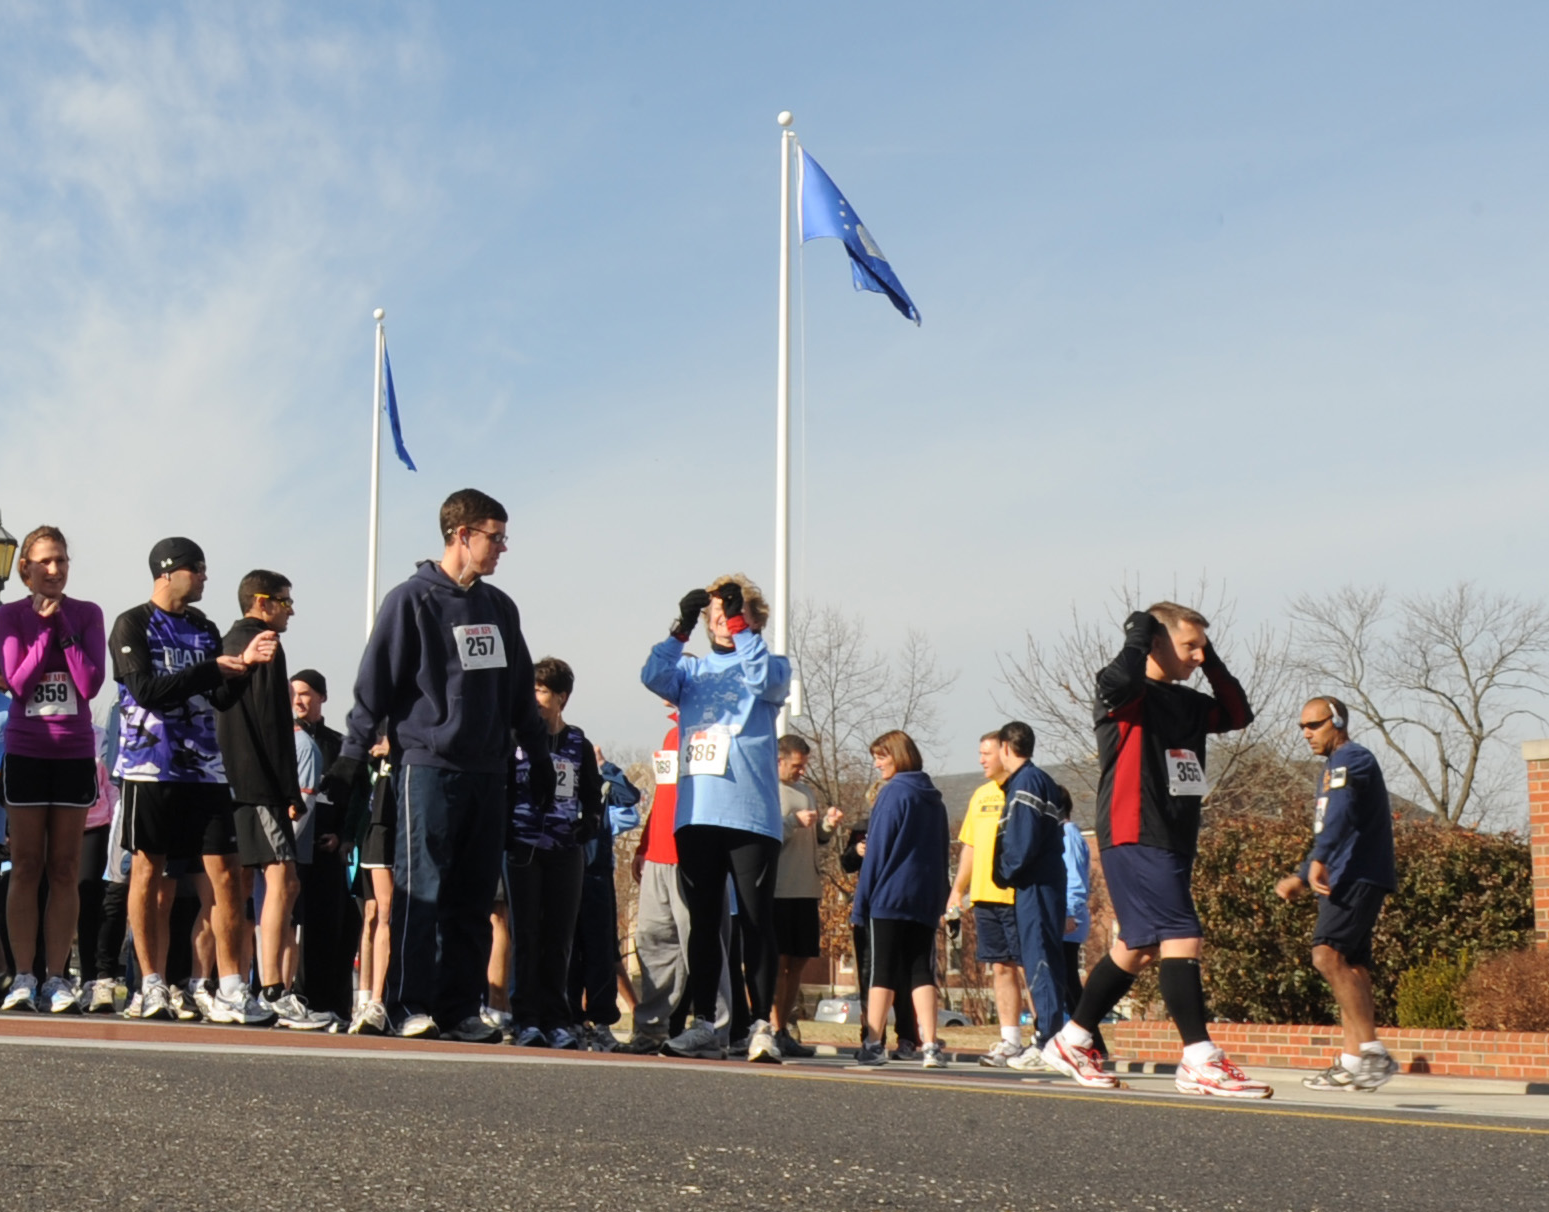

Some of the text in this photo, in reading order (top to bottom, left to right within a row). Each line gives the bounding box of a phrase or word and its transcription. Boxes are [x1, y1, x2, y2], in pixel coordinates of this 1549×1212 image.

[465, 635, 495, 657] 257
[34, 683, 68, 704] 359
[685, 743, 717, 763] 386
[1176, 761, 1202, 783] 355
